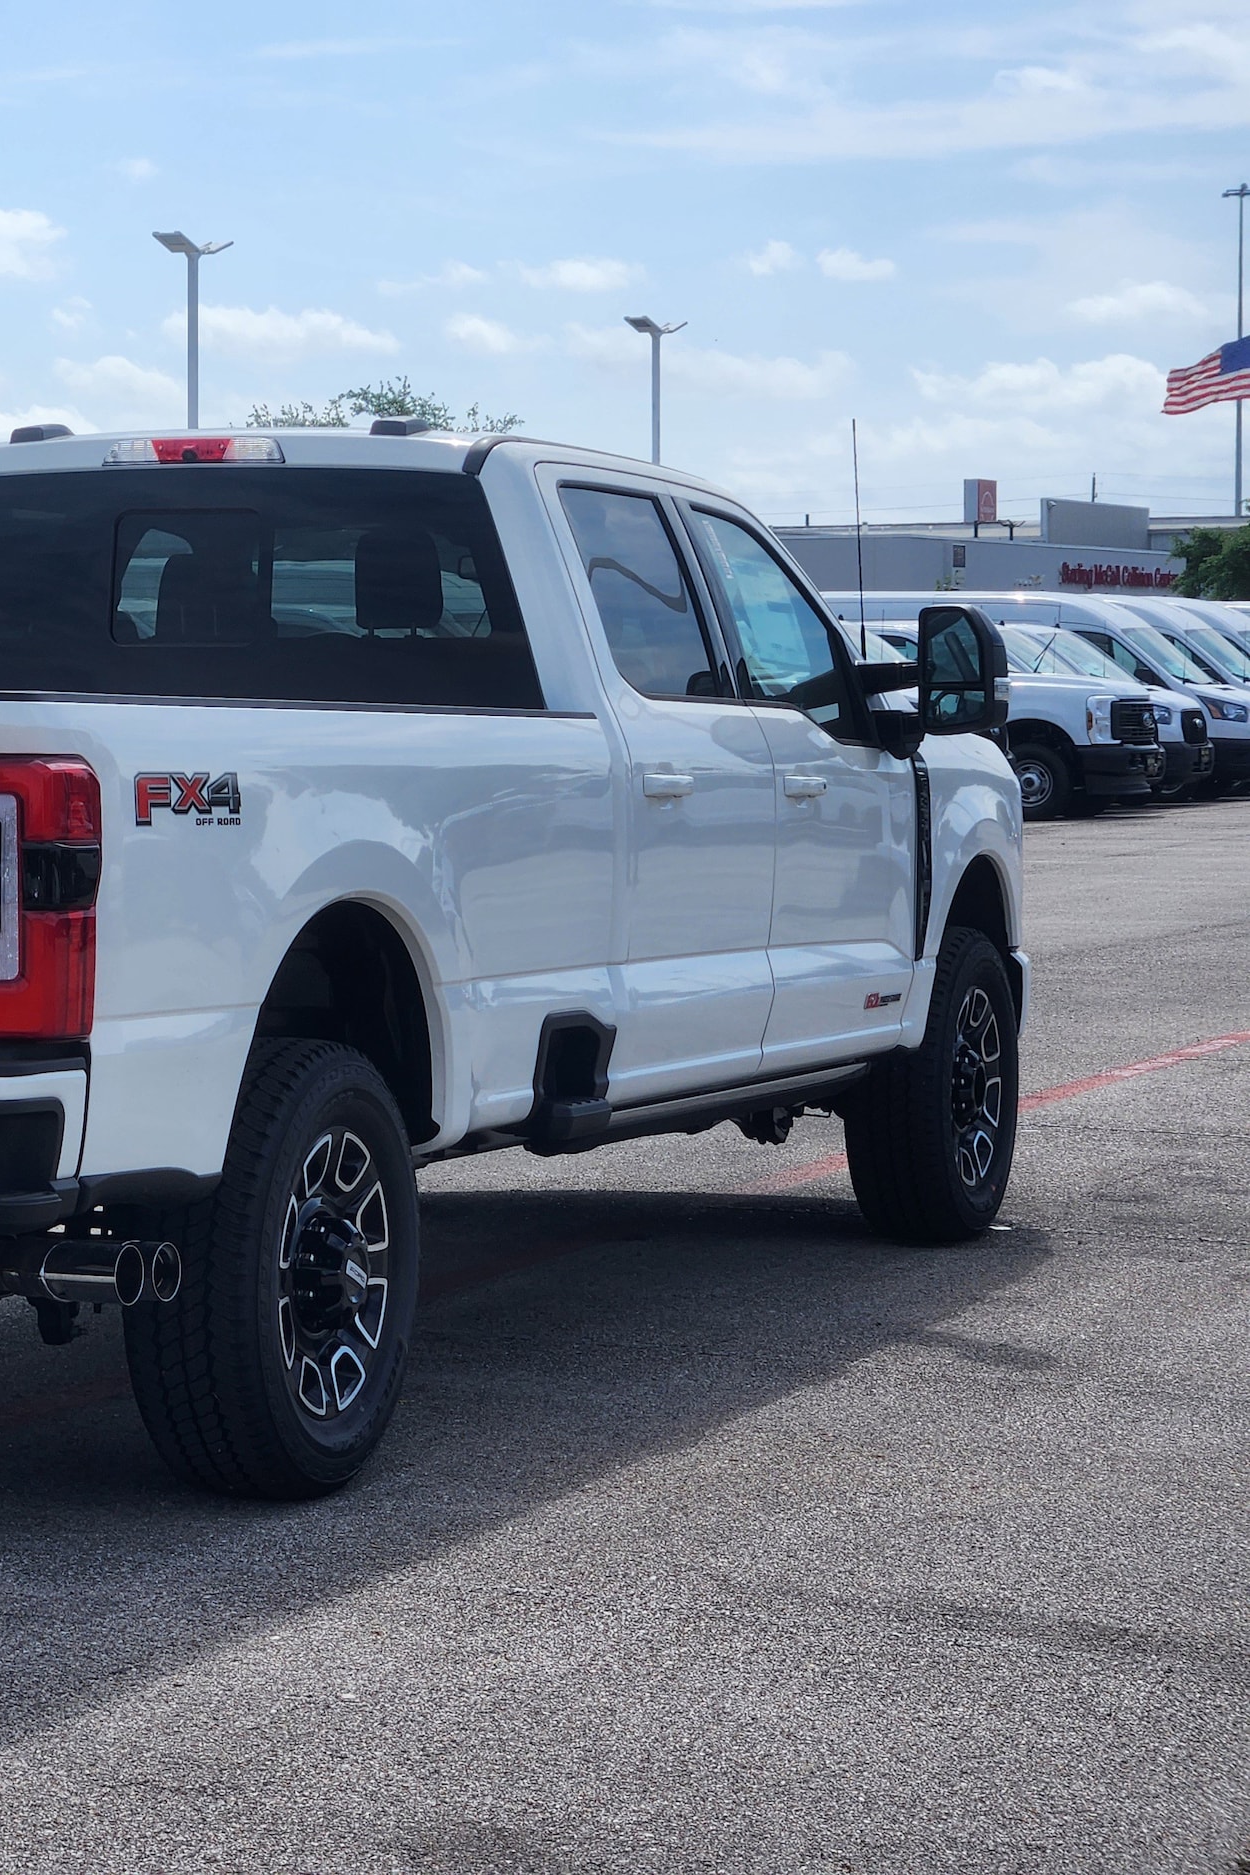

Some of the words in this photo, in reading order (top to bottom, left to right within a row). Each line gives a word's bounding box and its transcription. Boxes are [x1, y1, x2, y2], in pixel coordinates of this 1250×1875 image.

[134, 771, 241, 827] FX4
[195, 818, 214, 826] OFF
[217, 818, 241, 826] ROAD
